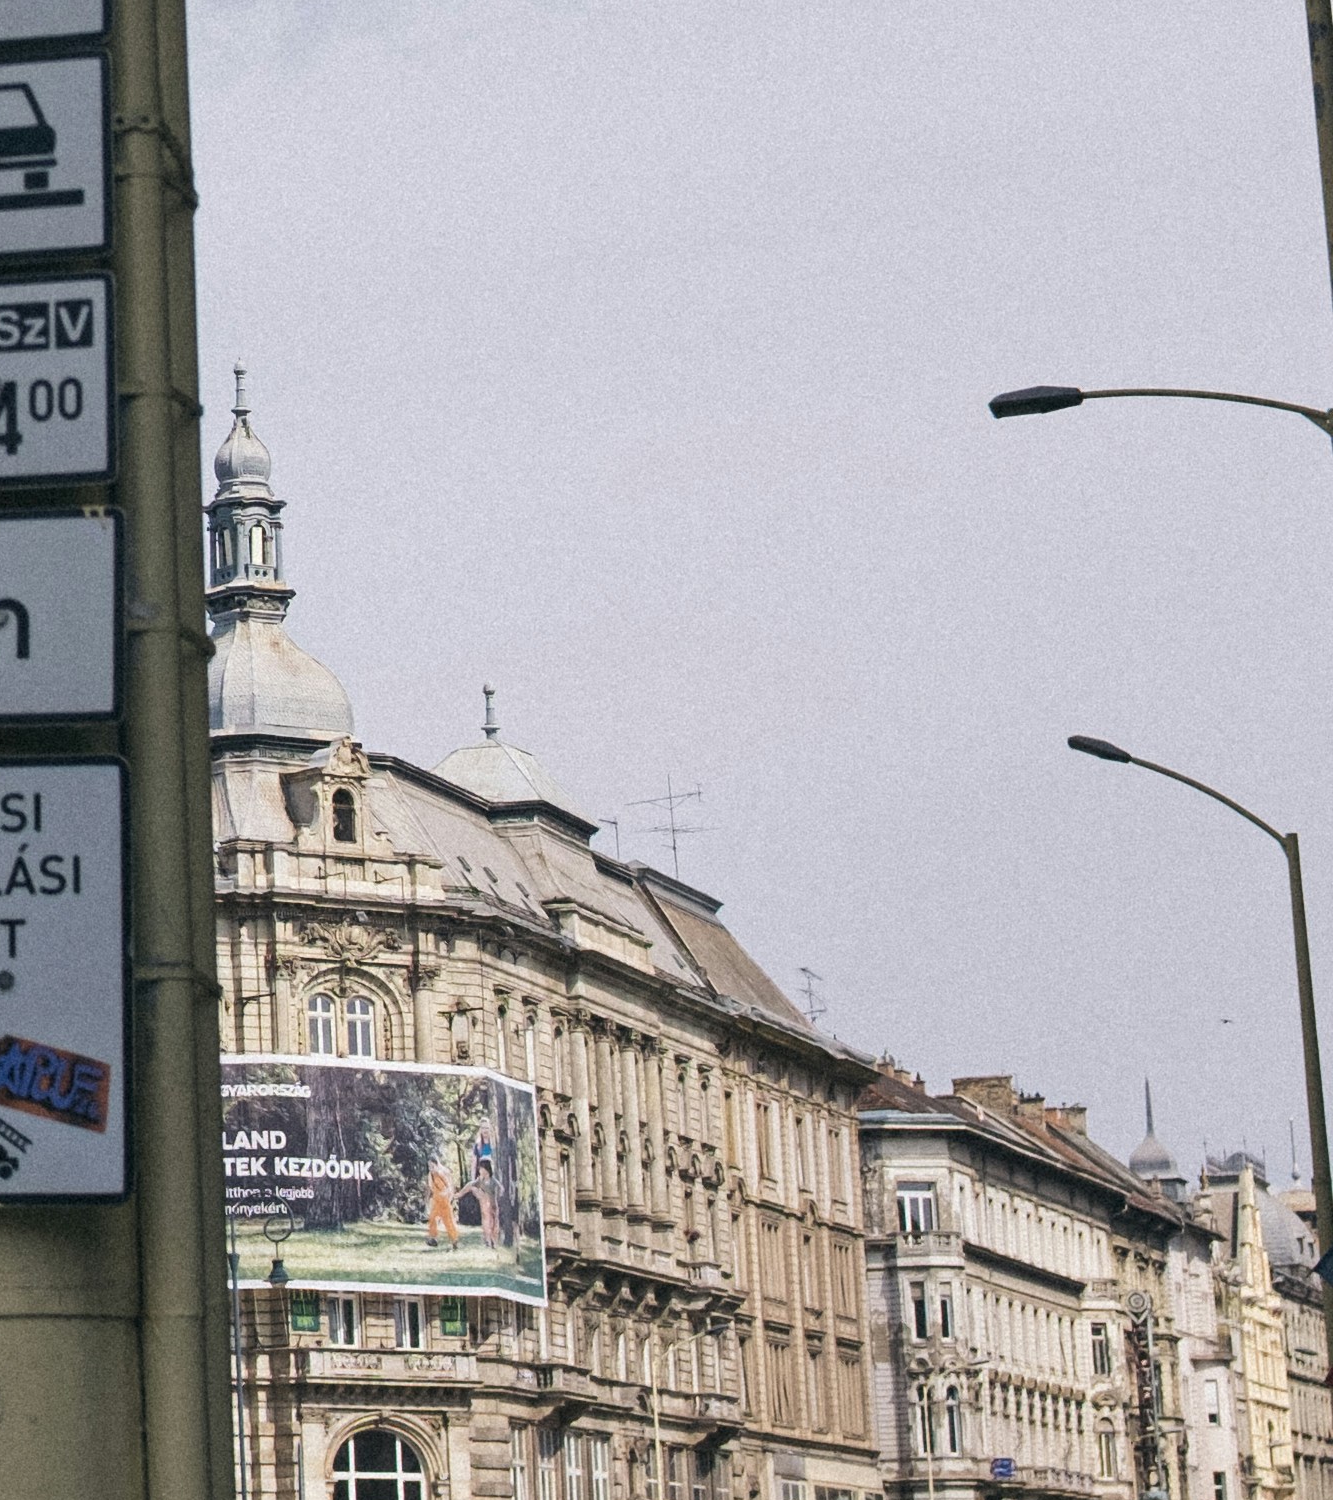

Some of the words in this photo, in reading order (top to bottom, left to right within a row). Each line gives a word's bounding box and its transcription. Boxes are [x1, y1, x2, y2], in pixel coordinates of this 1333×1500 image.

[222, 1130, 287, 1150] LAND
[223, 1157, 268, 1177] TEK
[274, 1153, 373, 1181] KEZDŐDIK
